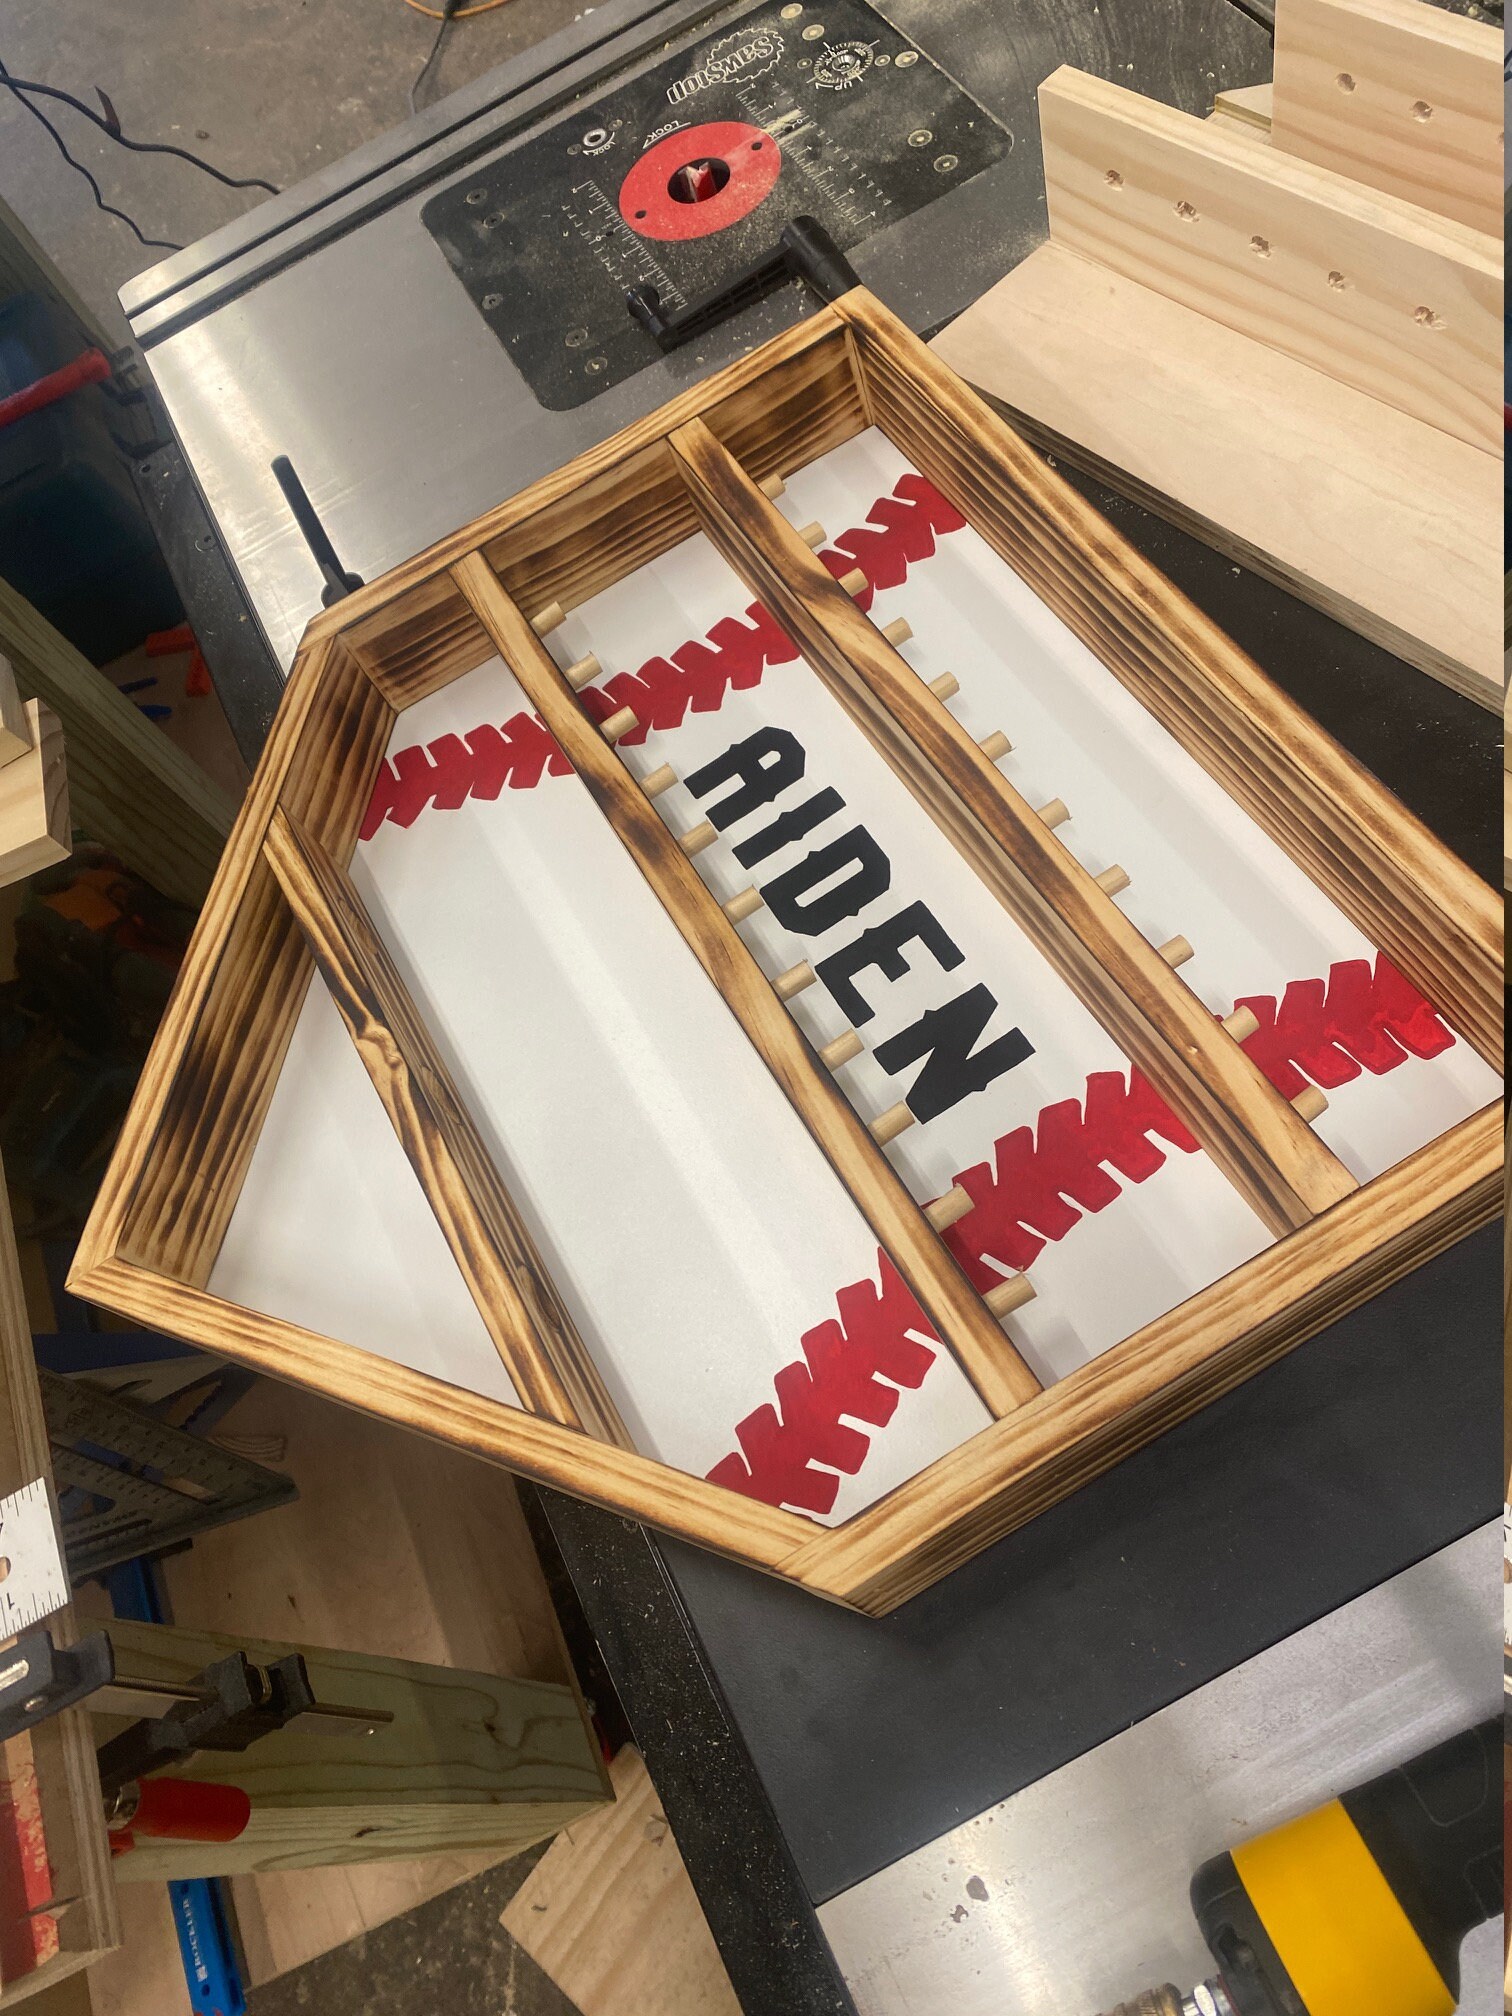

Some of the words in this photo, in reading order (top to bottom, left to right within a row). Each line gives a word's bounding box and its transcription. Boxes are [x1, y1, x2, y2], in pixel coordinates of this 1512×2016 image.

[666, 36, 774, 104] SawStop
[835, 81, 853, 91] UP
[592, 140, 616, 156] LOCK
[647, 120, 680, 141] LOCK
[683, 726, 1036, 1125] AIDEN
[183, 1898, 201, 1967] ROCKLER
